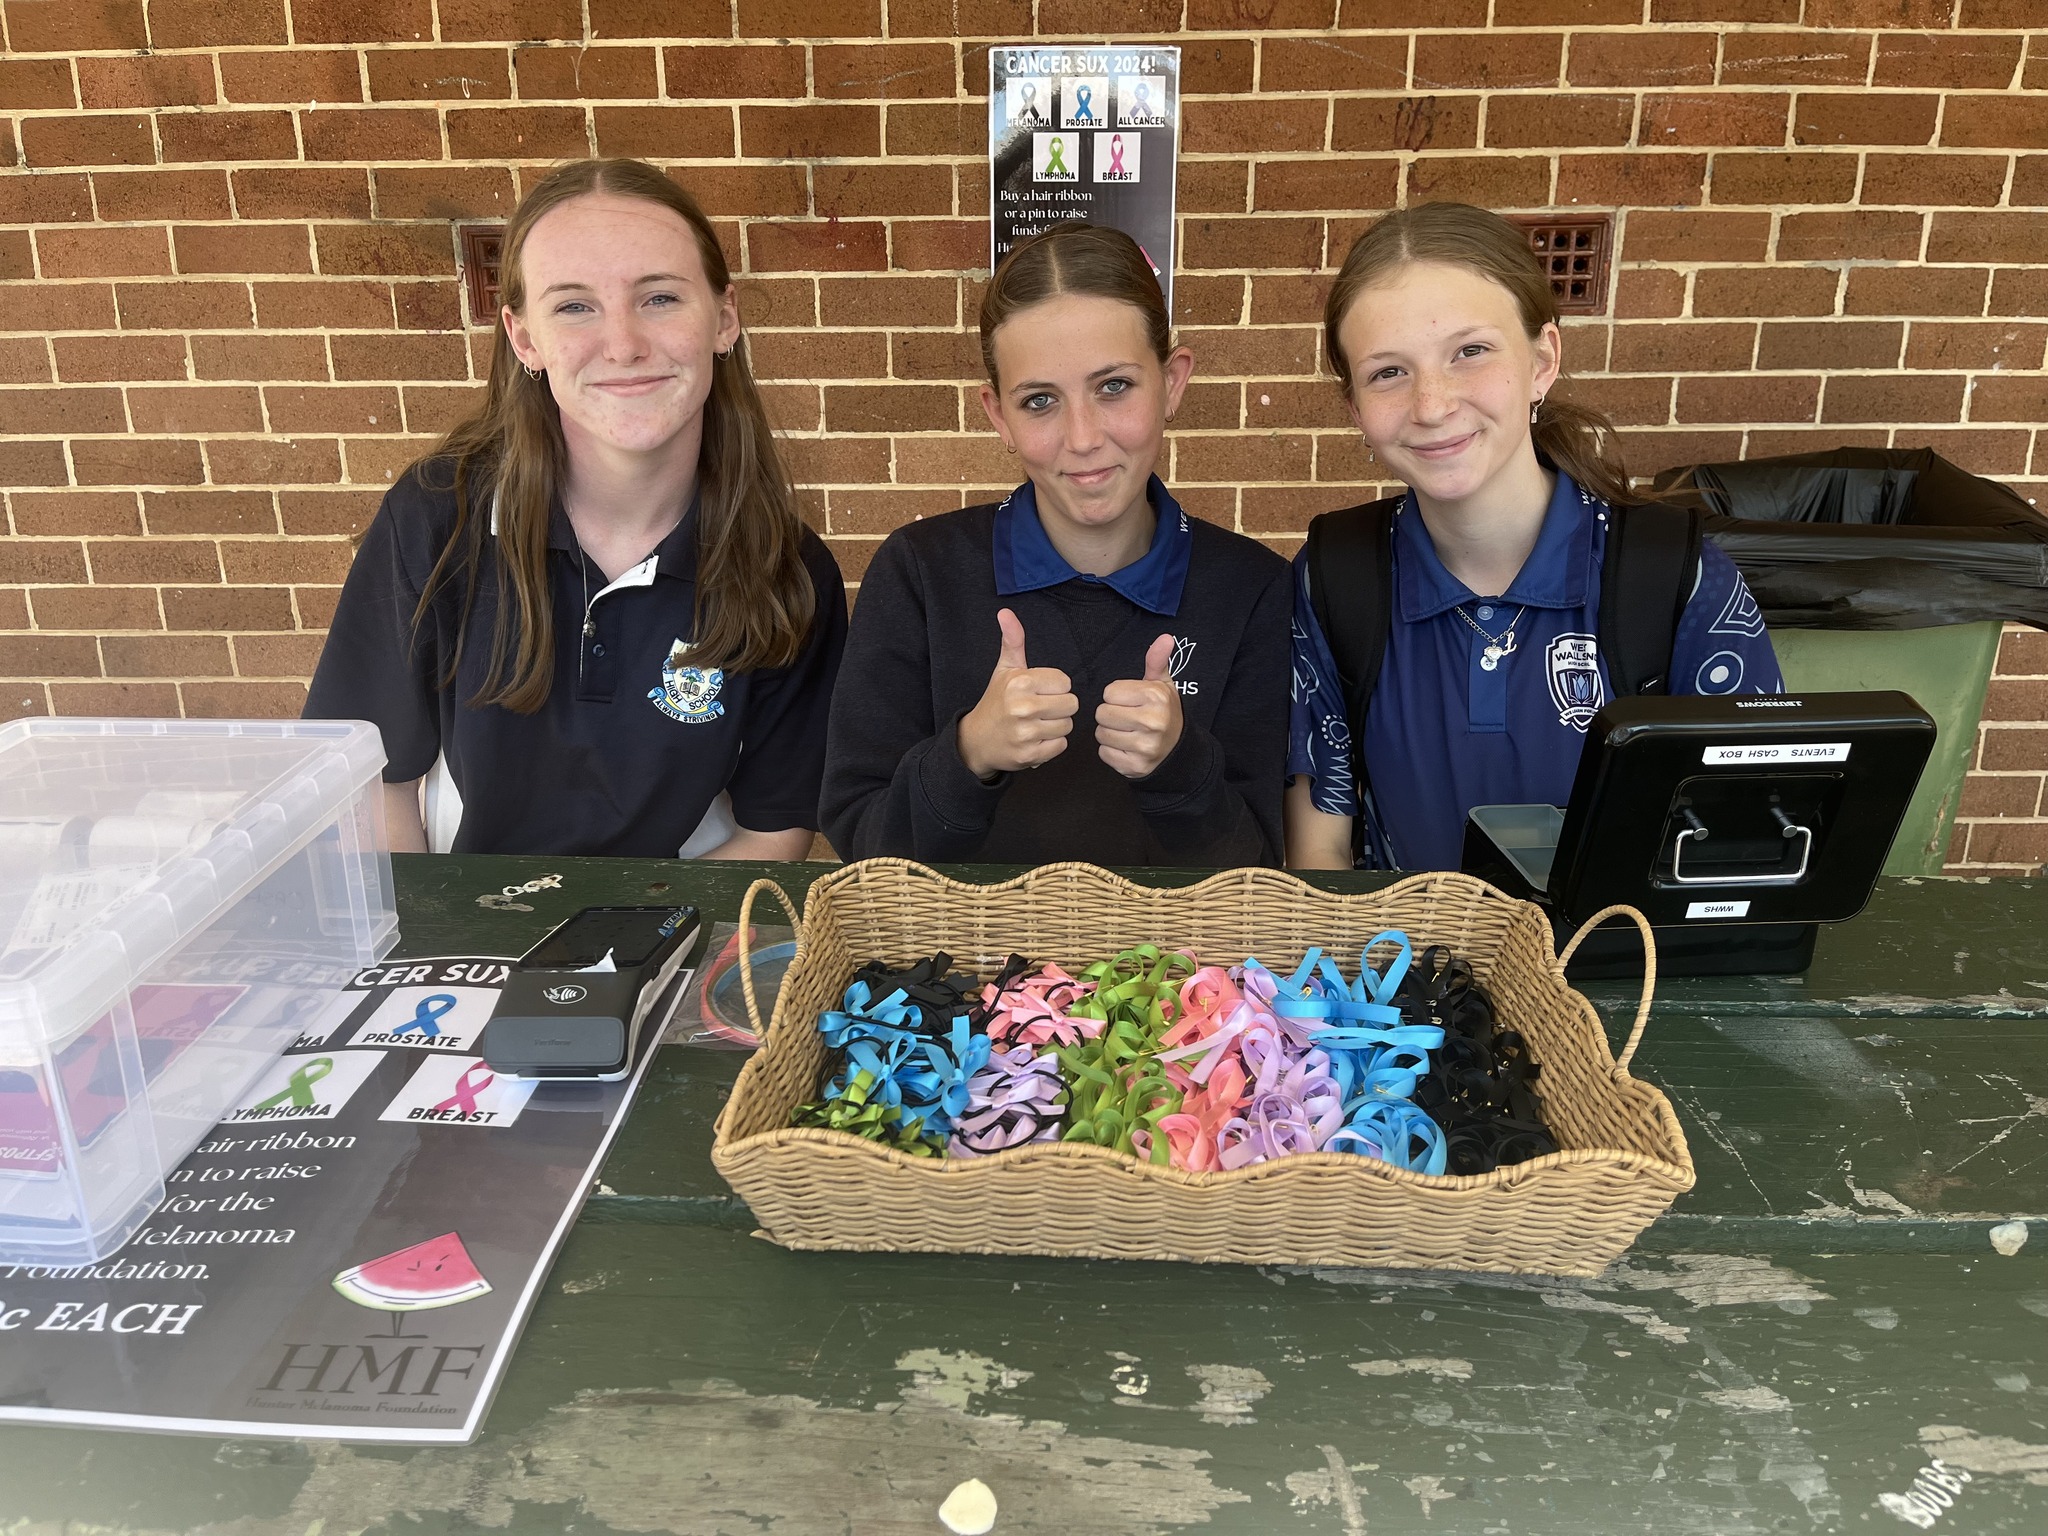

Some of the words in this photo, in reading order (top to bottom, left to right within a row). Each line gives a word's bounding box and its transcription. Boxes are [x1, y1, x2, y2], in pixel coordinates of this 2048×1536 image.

[1006, 55, 1067, 73] CANCER
[1076, 55, 1109, 73] SUX
[1113, 55, 1156, 73] 2024!
[1006, 117, 1050, 127] MELANOMA
[1065, 118, 1103, 127] PROSTATE
[1118, 117, 1132, 126] ALL
[1133, 117, 1165, 126] CANCER
[1035, 171, 1076, 180] LYMPHOMA
[1102, 172, 1133, 180] BREAST
[1000, 190, 1021, 203] Buy
[1022, 193, 1031, 201] a
[1031, 189, 1054, 201] hair
[1055, 190, 1092, 201] ribbon
[1004, 210, 1018, 218] or
[1019, 210, 1027, 218] a
[1028, 208, 1046, 221] pin
[1047, 208, 1059, 218] to
[1061, 208, 1088, 218] raise
[1012, 225, 1042, 236] funds
[665, 680, 682, 703] HIGH
[688, 685, 720, 710] SCHOOL
[655, 700, 681, 720] ALWAYS
[683, 713, 716, 723] STRIVING
[1719, 750, 1742, 758] BOX
[1748, 749, 1779, 758] CASH
[1791, 748, 1835, 757] EVENTS
[1704, 906, 1734, 914] WWHS
[361, 1033, 462, 1048] PROSTATE
[221, 1104, 332, 1121] YMPHOMA
[406, 1107, 498, 1124] BREAST
[193, 1138, 244, 1154] air
[246, 1131, 357, 1151] ribbon
[199, 1167, 234, 1182] to
[238, 1162, 322, 1180] raise
[159, 1192, 216, 1213] for
[218, 1191, 275, 1211] the
[34, 1302, 202, 1335] EACH
[255, 1343, 486, 1396] HMF
[245, 1397, 296, 1410] Hunter
[299, 1399, 371, 1413] Melanoma
[375, 1401, 457, 1414] Foundation
